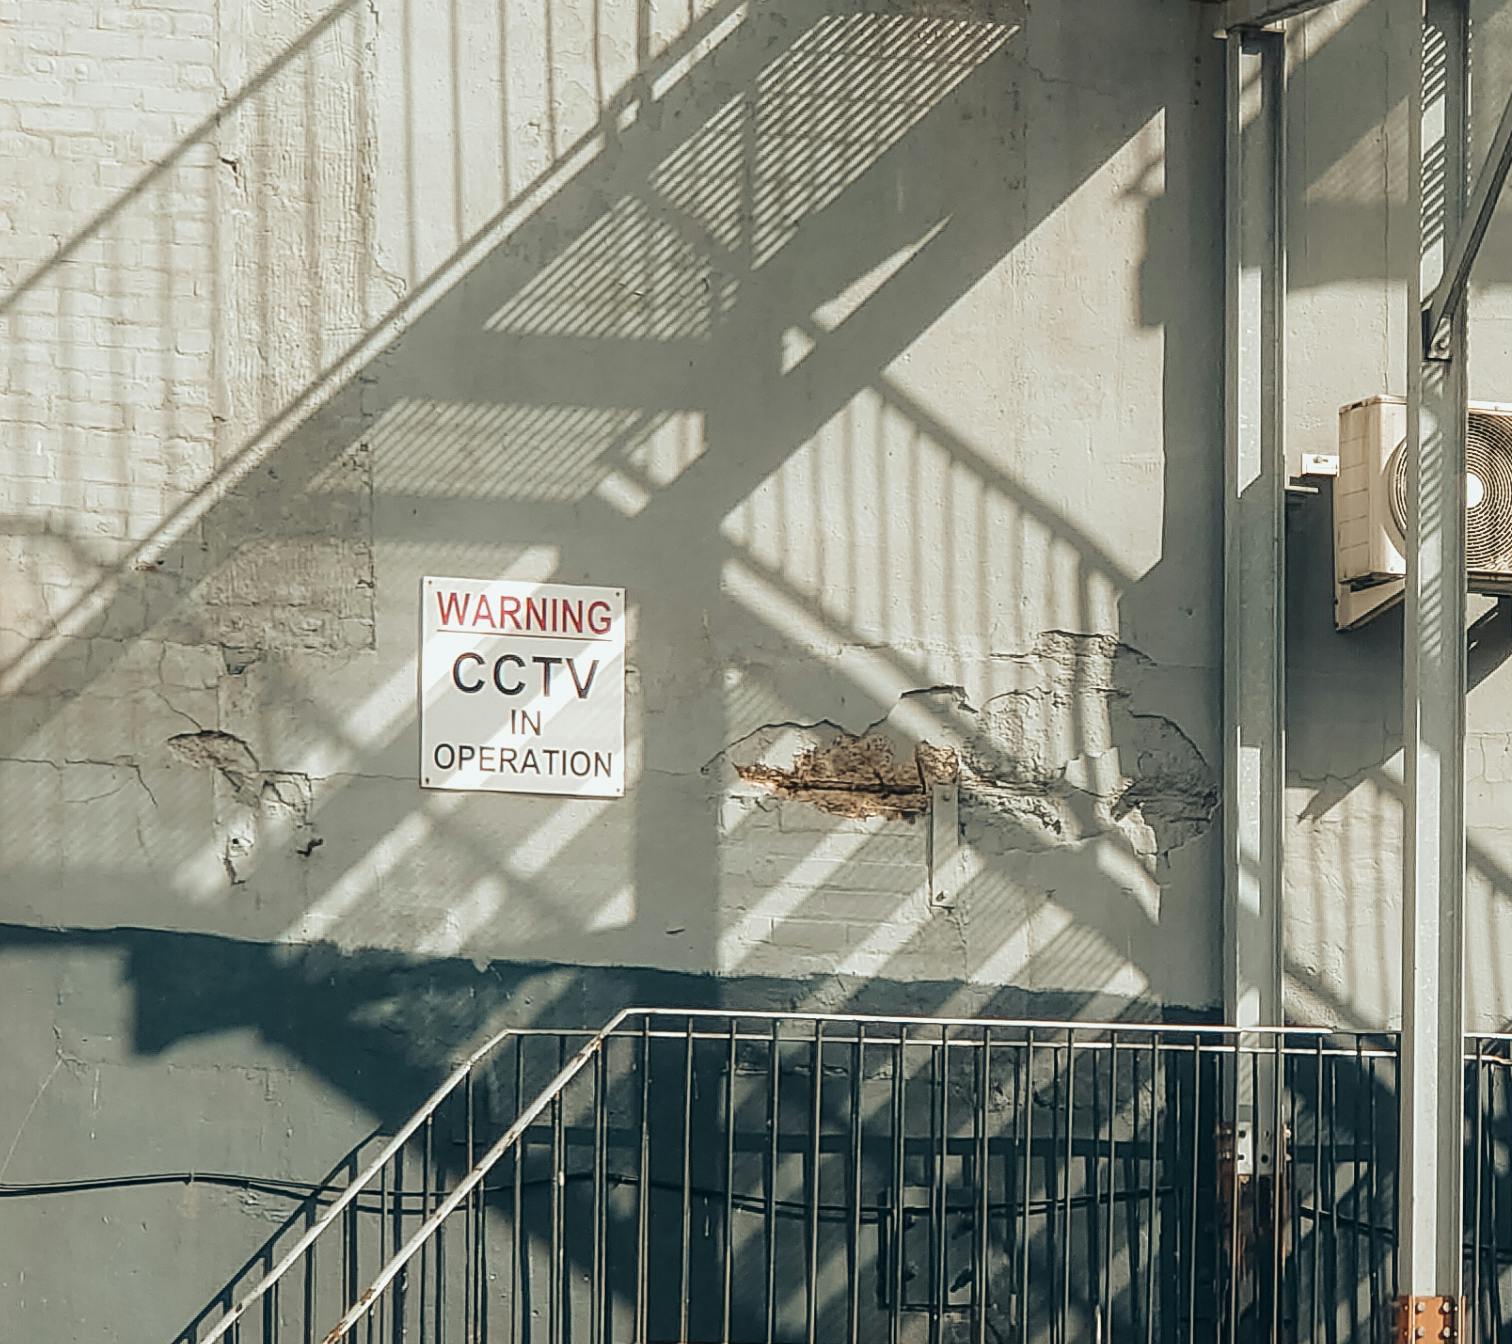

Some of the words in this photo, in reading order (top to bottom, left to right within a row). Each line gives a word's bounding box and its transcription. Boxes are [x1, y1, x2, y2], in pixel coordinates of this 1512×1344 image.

[437, 591, 613, 635] WARNING
[453, 652, 600, 699] CCTV
[511, 709, 541, 736] IN
[434, 743, 612, 777] OPERATION
